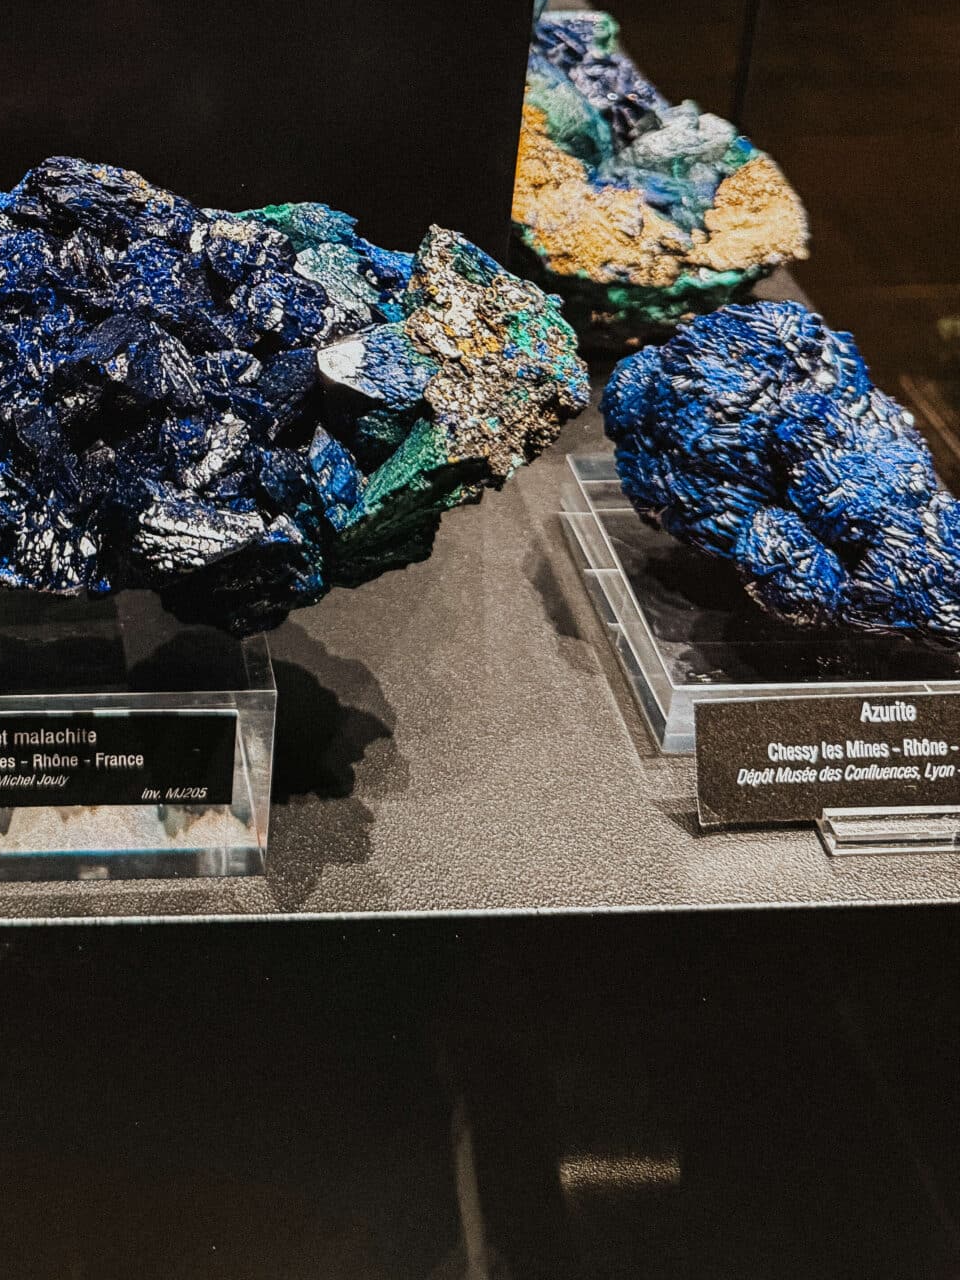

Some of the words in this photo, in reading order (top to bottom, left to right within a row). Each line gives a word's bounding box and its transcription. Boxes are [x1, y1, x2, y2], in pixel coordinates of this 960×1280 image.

[860, 701, 917, 722] Azurite
[13, 729, 97, 746] malachite
[768, 743, 818, 763] Chessy
[822, 742, 844, 759] les
[846, 741, 889, 759] Mines
[903, 739, 947, 757] Rhône
[33, 753, 78, 769] Rhône
[95, 753, 144, 768] France
[737, 768, 775, 787] Dépôt
[775, 767, 817, 783] Musée
[819, 767, 842, 782] des
[844, 765, 921, 781] Confluences,
[924, 763, 954, 781] Lyon
[142, 788, 161, 800] inv.
[166, 786, 207, 799] MJ205
